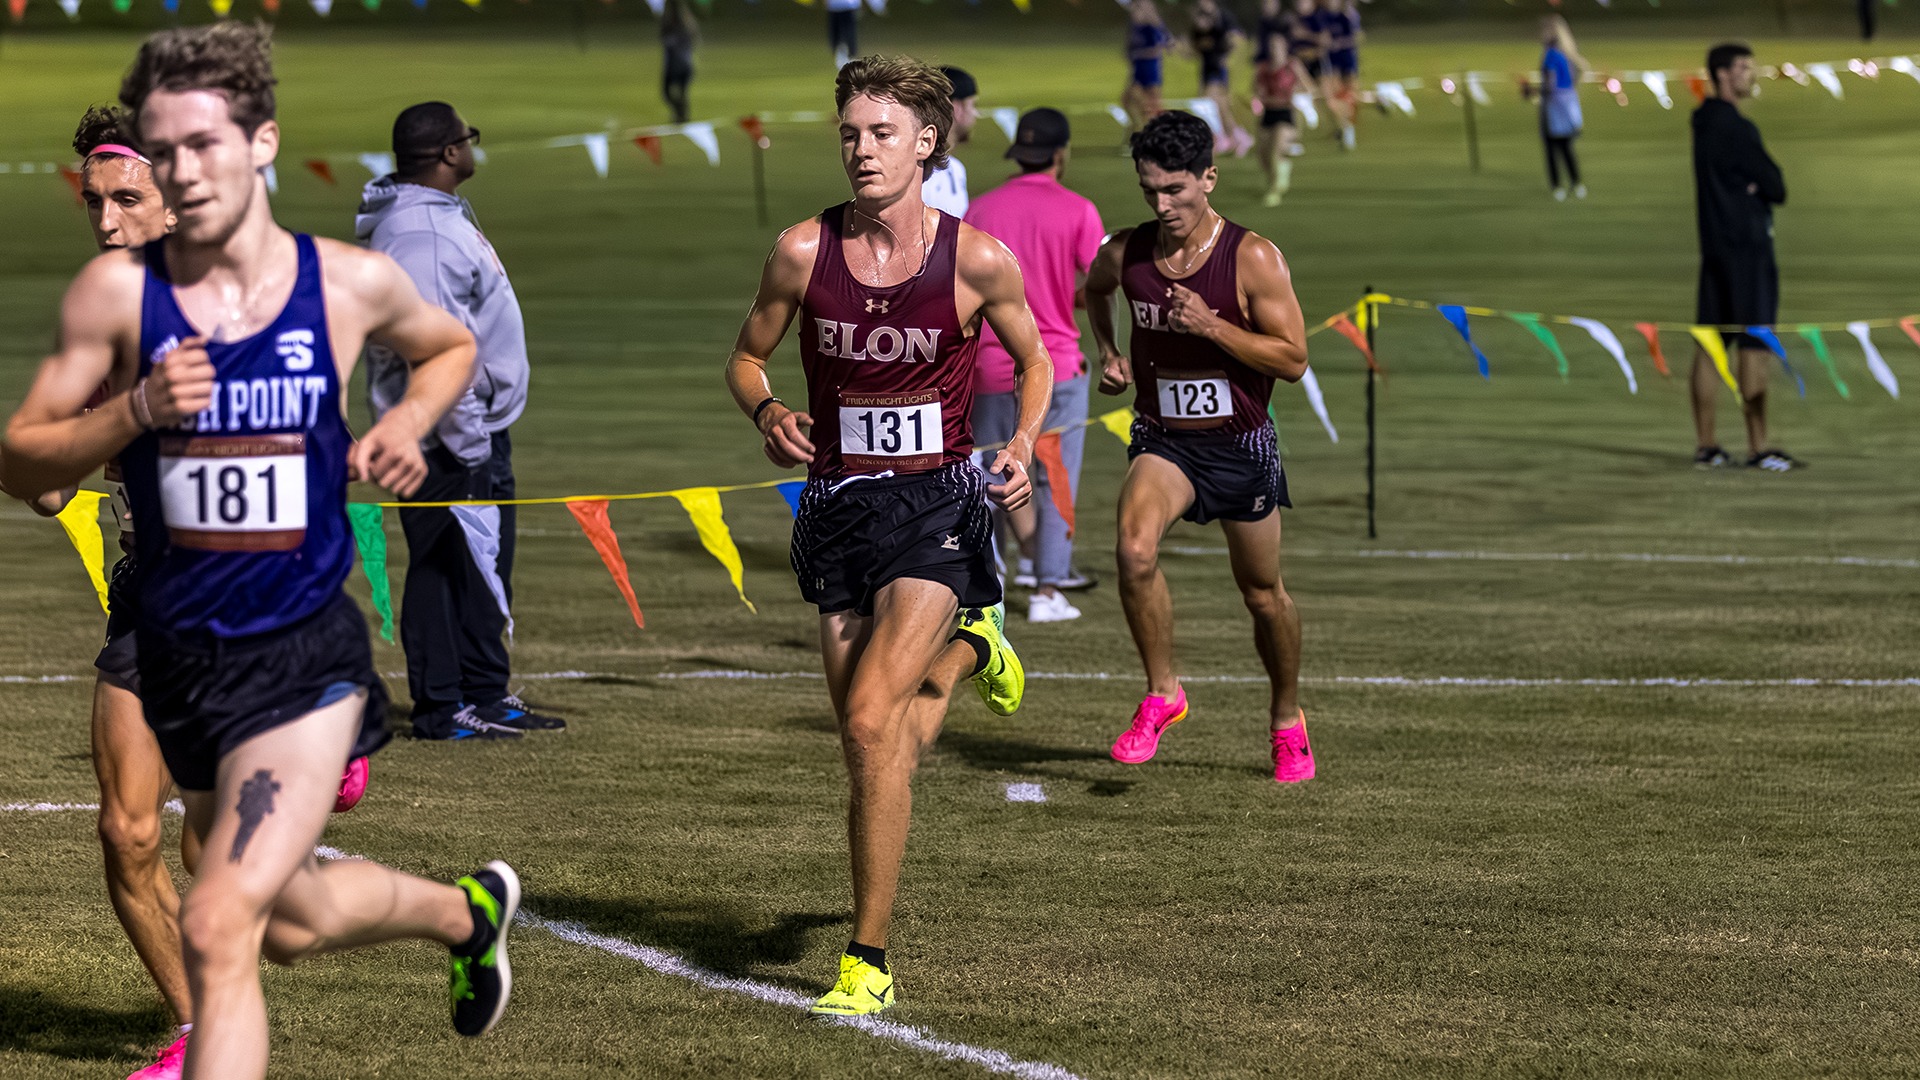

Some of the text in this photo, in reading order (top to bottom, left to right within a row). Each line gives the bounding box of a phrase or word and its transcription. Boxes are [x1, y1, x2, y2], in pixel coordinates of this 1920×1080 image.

[814, 317, 943, 363] ELON
[227, 375, 328, 432] POINT
[846, 393, 933, 405] FRIDAY NIGHT LIGHTS
[1169, 382, 1219, 415] 123
[858, 409, 923, 453] 131
[187, 464, 277, 524] 181
